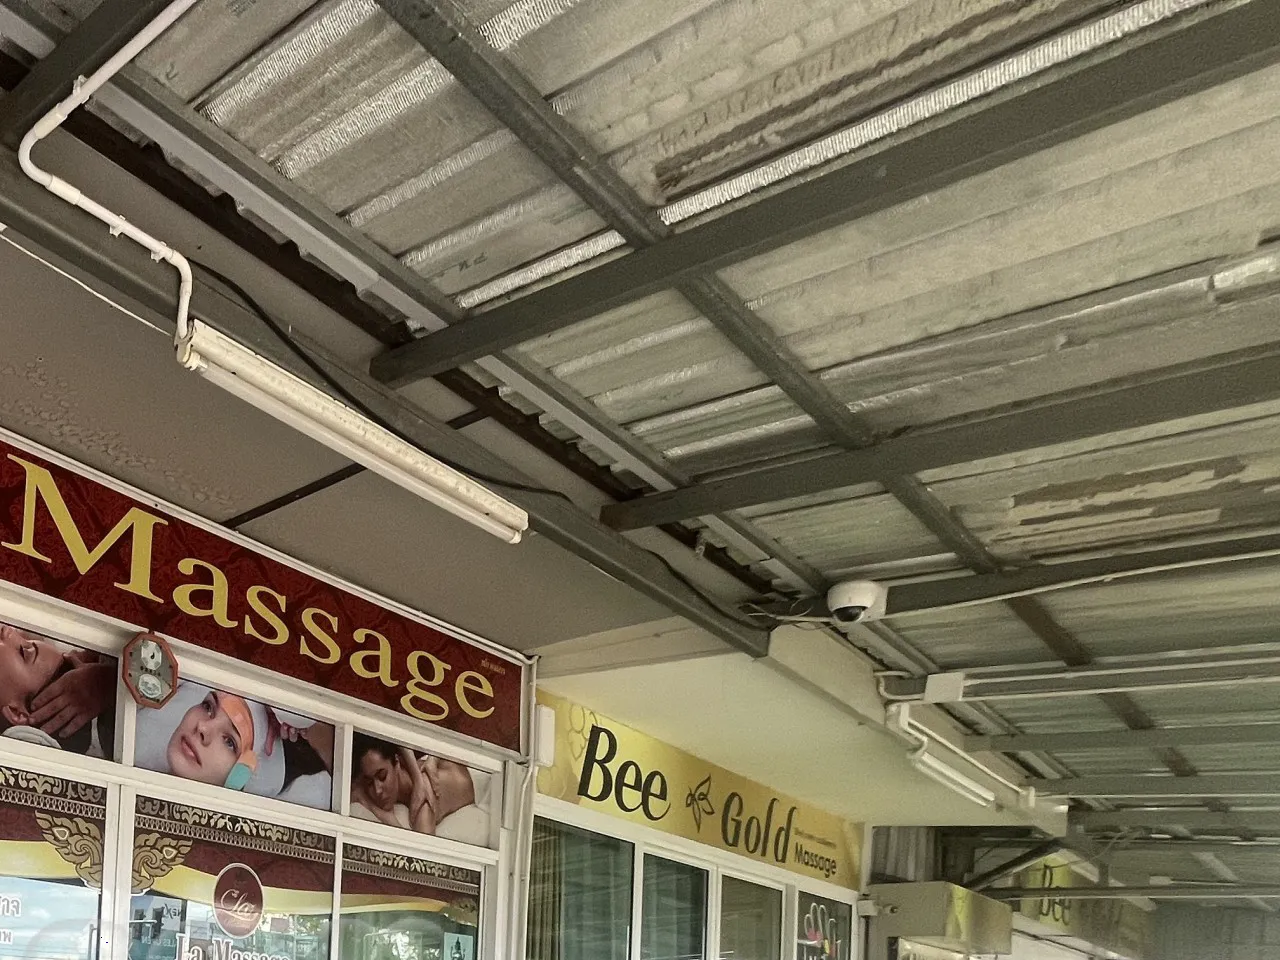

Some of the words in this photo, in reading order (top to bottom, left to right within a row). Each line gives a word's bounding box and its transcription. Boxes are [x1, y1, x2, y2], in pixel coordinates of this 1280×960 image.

[1, 453, 496, 722] Massage
[577, 724, 671, 821] Bee
[722, 791, 797, 863] Gold
[794, 842, 837, 878] Massage
